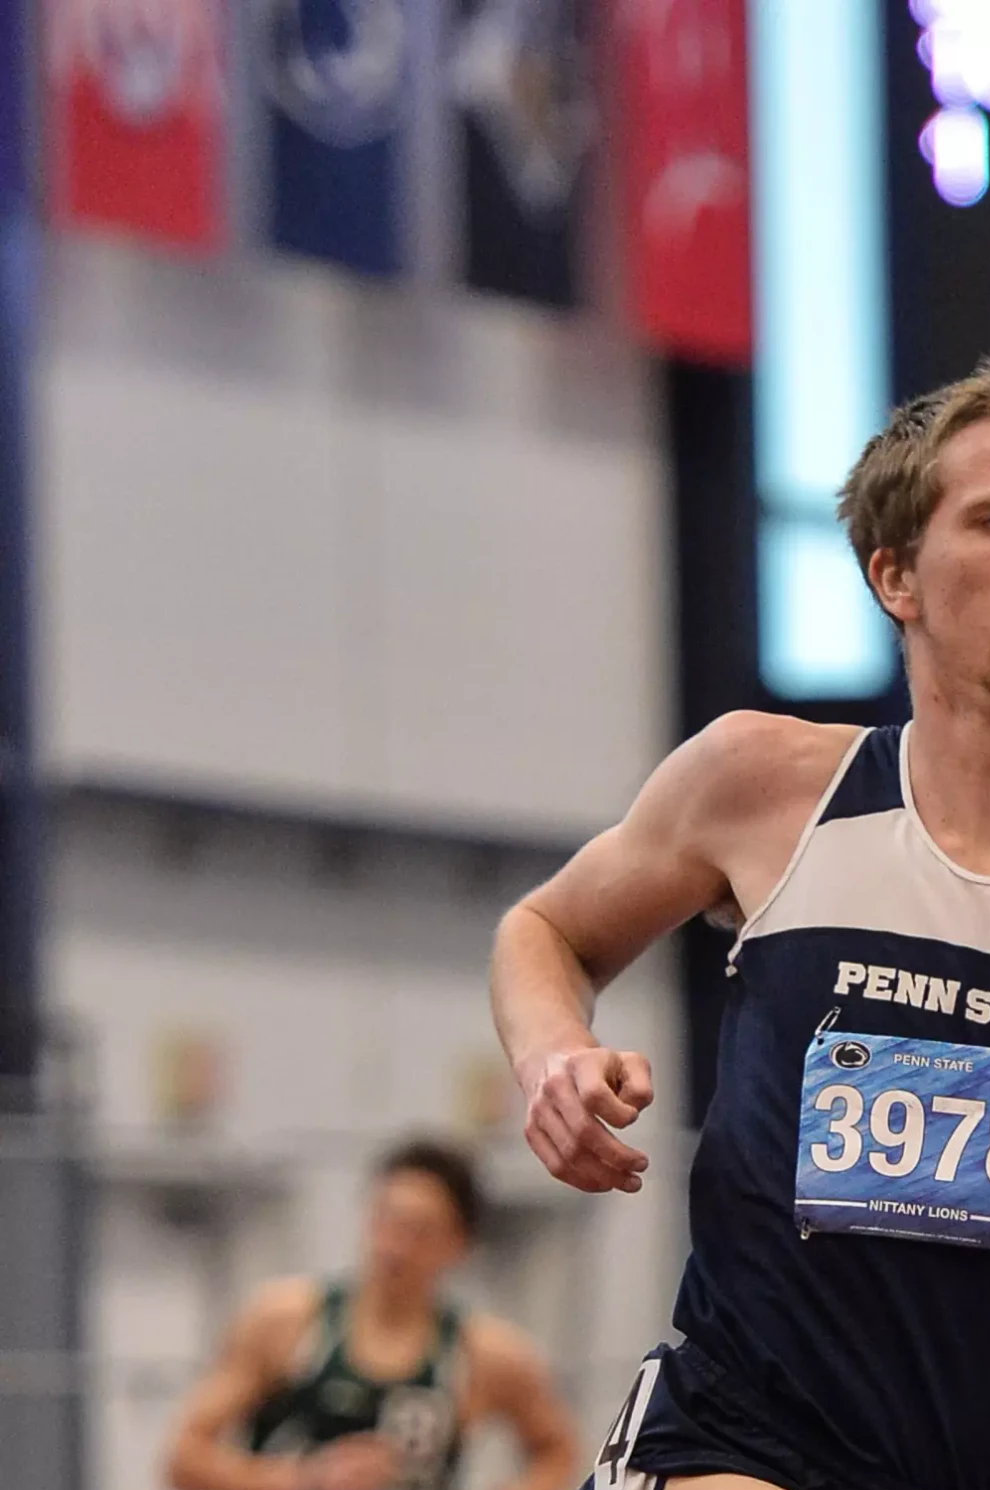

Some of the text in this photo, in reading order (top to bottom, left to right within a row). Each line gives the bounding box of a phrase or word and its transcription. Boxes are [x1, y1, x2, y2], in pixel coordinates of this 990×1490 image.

[833, 961, 961, 1015] PENN
[893, 1053, 974, 1073] PENN STATE
[869, 1199, 969, 1221] NITTANY LIONS
[598, 1368, 645, 1486] 4
